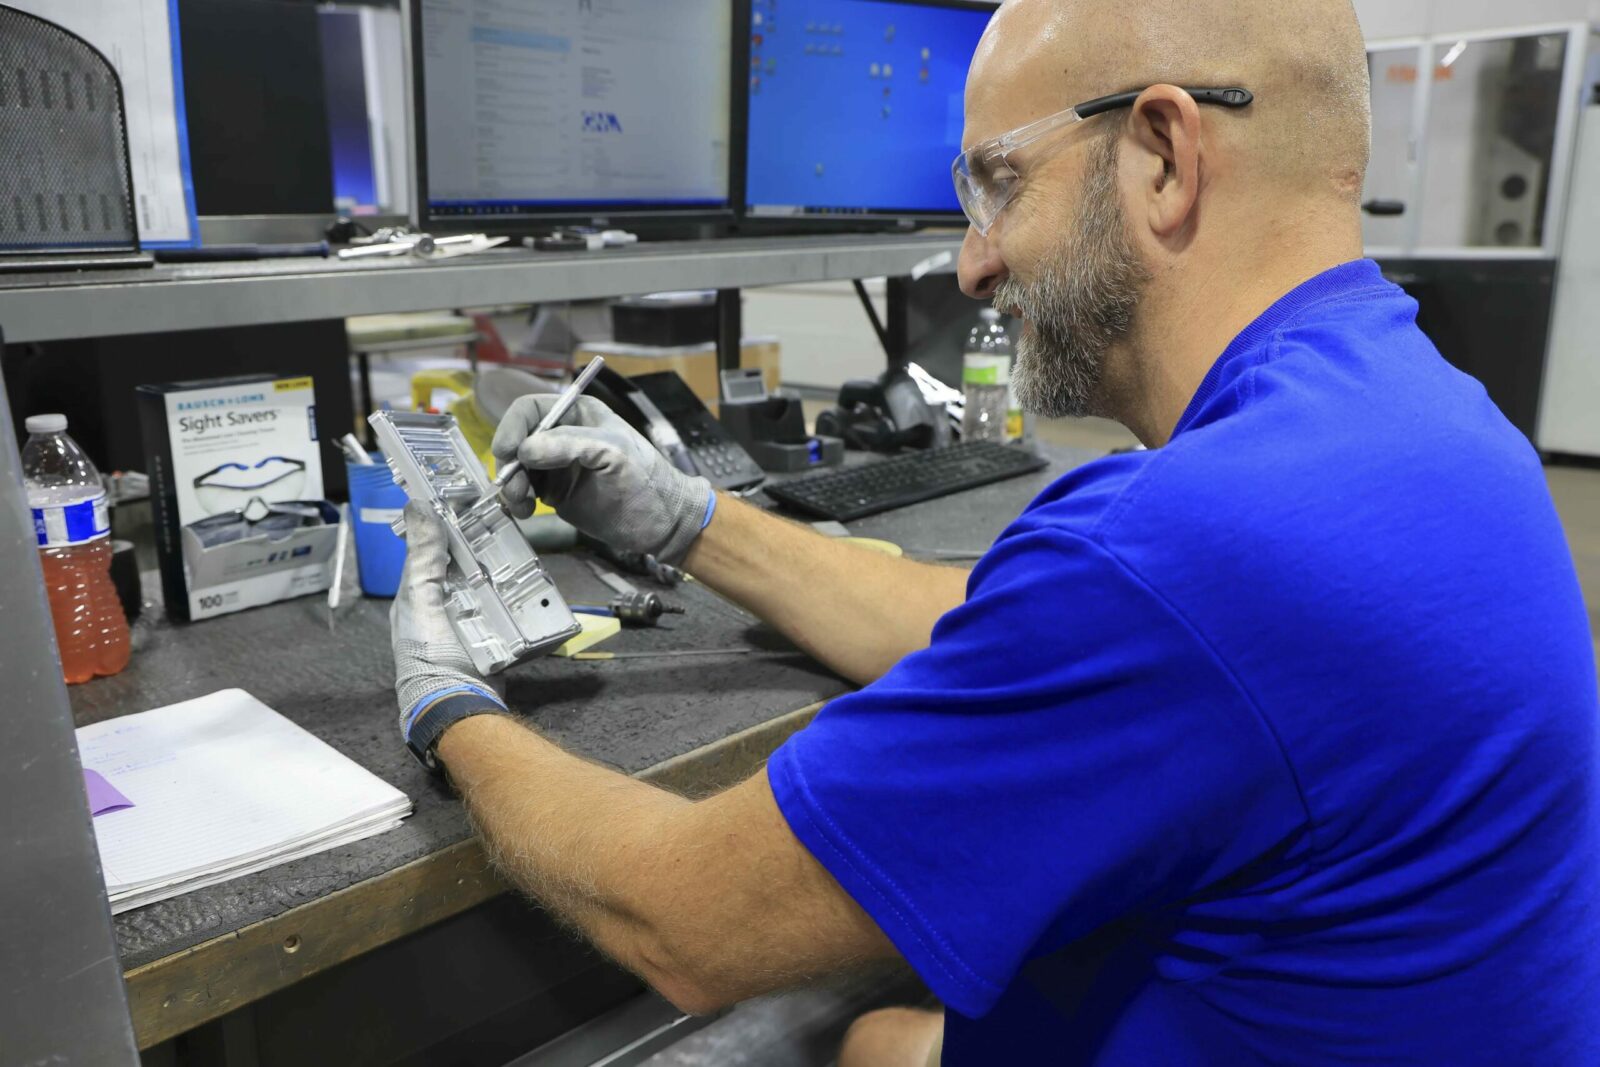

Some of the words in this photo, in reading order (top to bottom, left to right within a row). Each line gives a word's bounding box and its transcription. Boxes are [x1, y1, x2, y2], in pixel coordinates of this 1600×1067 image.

[179, 413, 222, 434] Sight
[227, 408, 277, 426] Savers
[199, 594, 222, 610] 100
